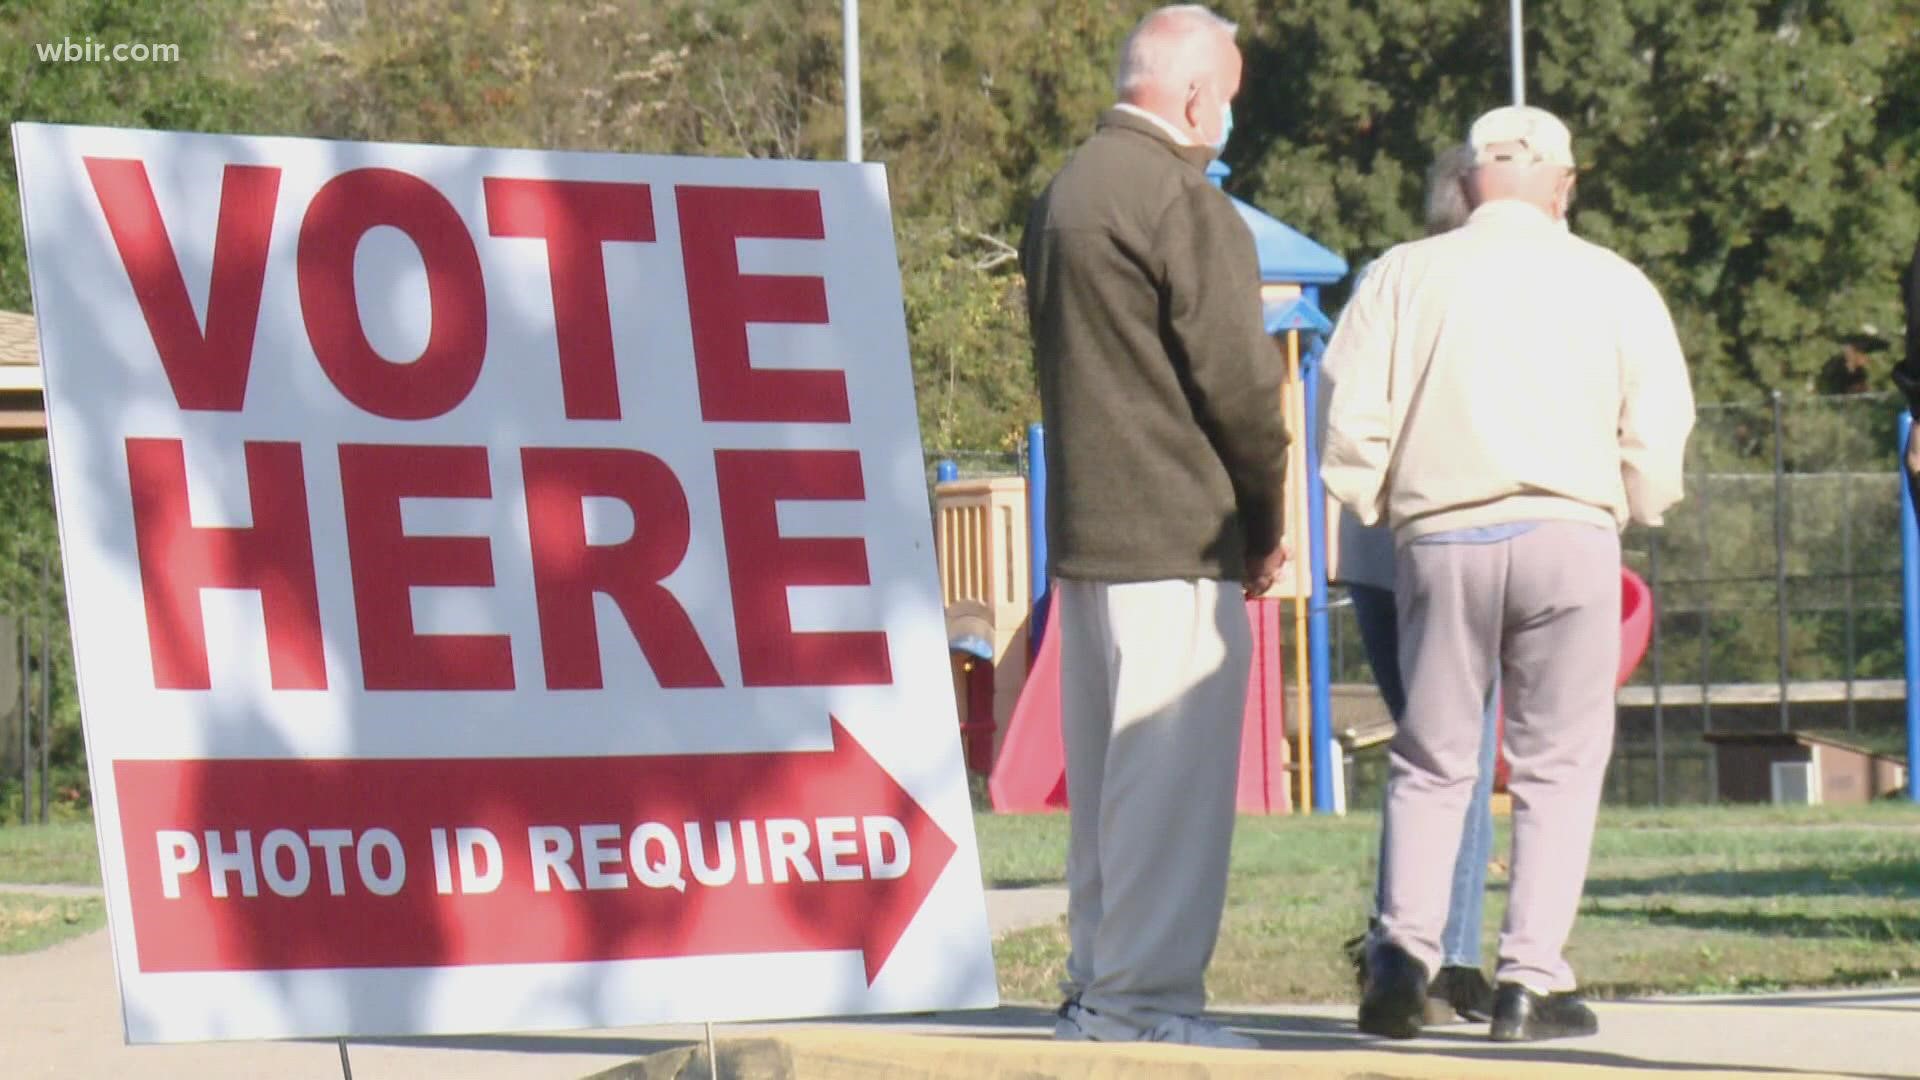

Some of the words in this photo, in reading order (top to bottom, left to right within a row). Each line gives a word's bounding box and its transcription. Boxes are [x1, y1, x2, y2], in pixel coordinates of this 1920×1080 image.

[84, 156, 850, 423] VOTE
[126, 438, 894, 691] HERE
[155, 827, 407, 900] PHOTO
[431, 826, 505, 896] ID
[528, 814, 912, 893] REQUIRED
